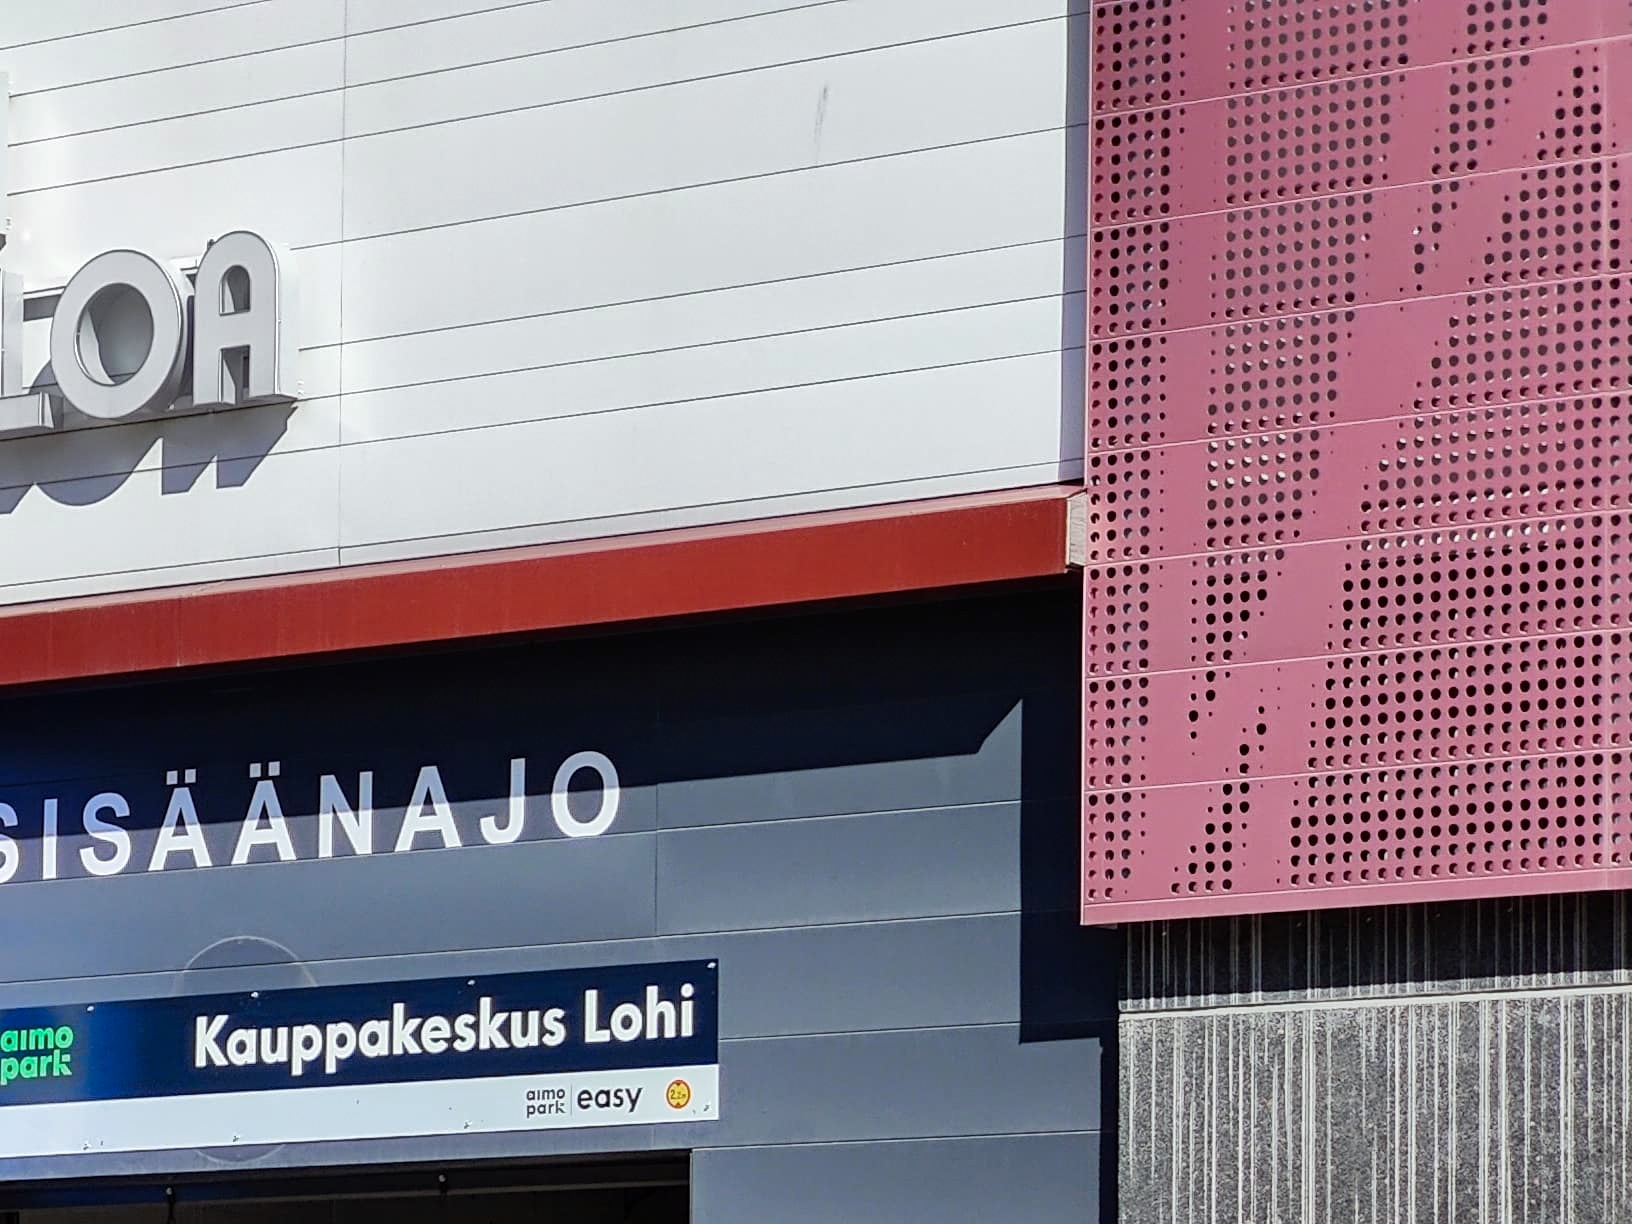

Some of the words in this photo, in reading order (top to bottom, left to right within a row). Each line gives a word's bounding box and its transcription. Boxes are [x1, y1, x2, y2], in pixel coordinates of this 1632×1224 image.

[0, 1025, 74, 1053] aimo
[195, 995, 567, 1078] Kauppakeskus
[583, 984, 695, 1044] Lohi
[0, 1049, 73, 1086] park
[526, 1100, 566, 1119] park
[576, 1087, 643, 1113] easy
